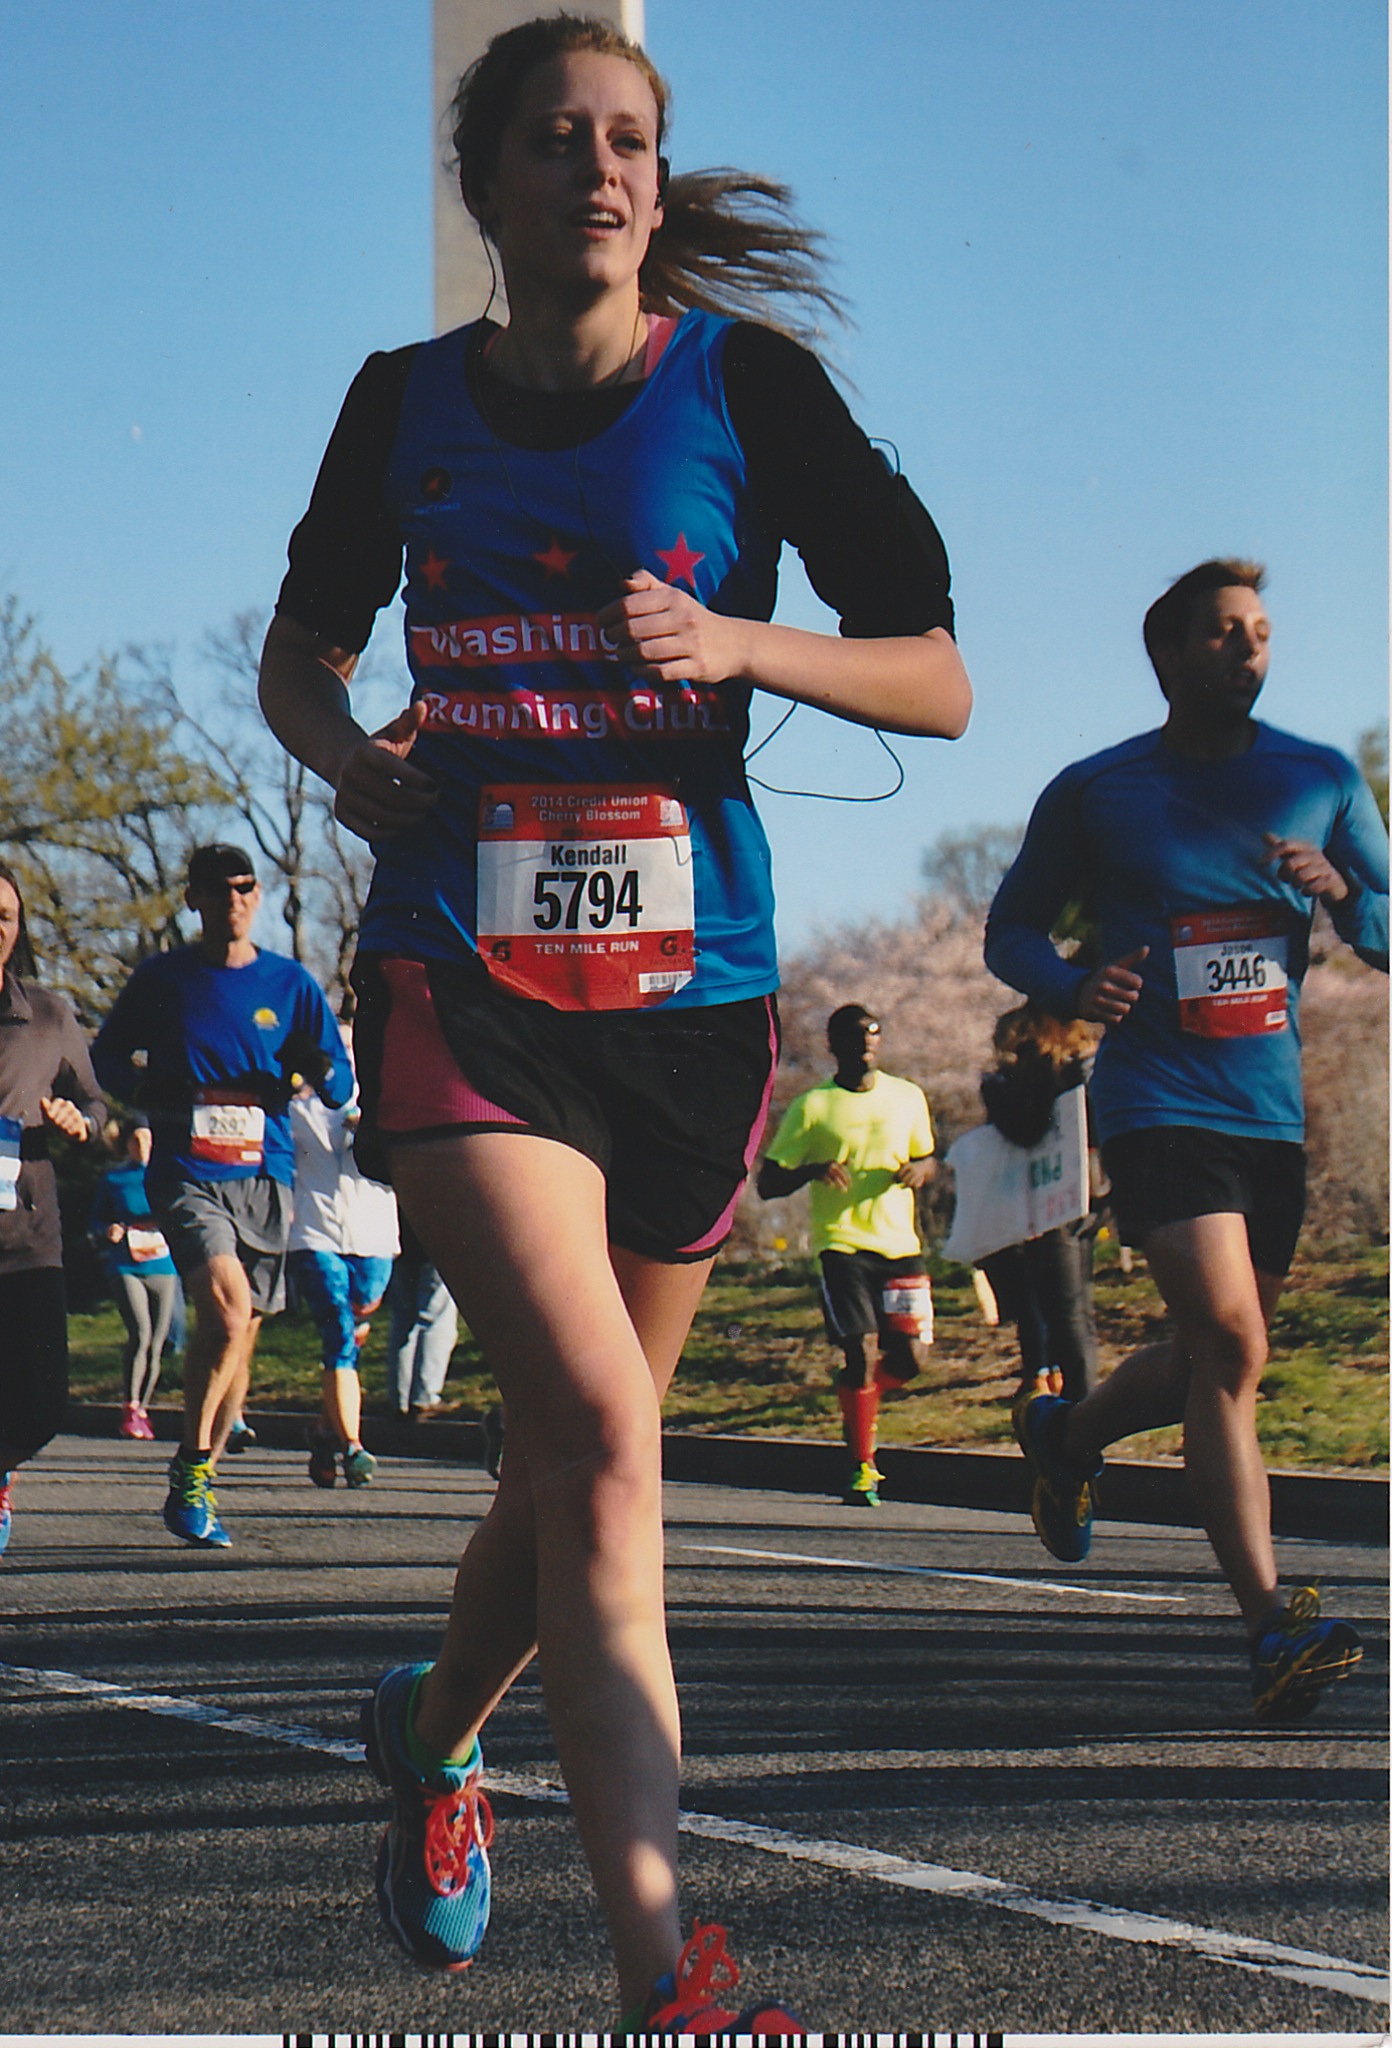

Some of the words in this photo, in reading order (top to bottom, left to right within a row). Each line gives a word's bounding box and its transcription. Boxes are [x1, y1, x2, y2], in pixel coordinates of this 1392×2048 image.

[422, 693, 607, 738] Running
[532, 796, 564, 808] 2014
[568, 795, 607, 808] Credit
[611, 795, 649, 807] Union
[539, 810, 581, 823] Cherry
[586, 809, 641, 820] Blossom
[551, 844, 627, 866] Kendall
[533, 870, 643, 931] 5794
[534, 943, 564, 955] TEN
[570, 942, 606, 954] MILE
[610, 940, 640, 952] RUN
[1207, 954, 1266, 993] 3446
